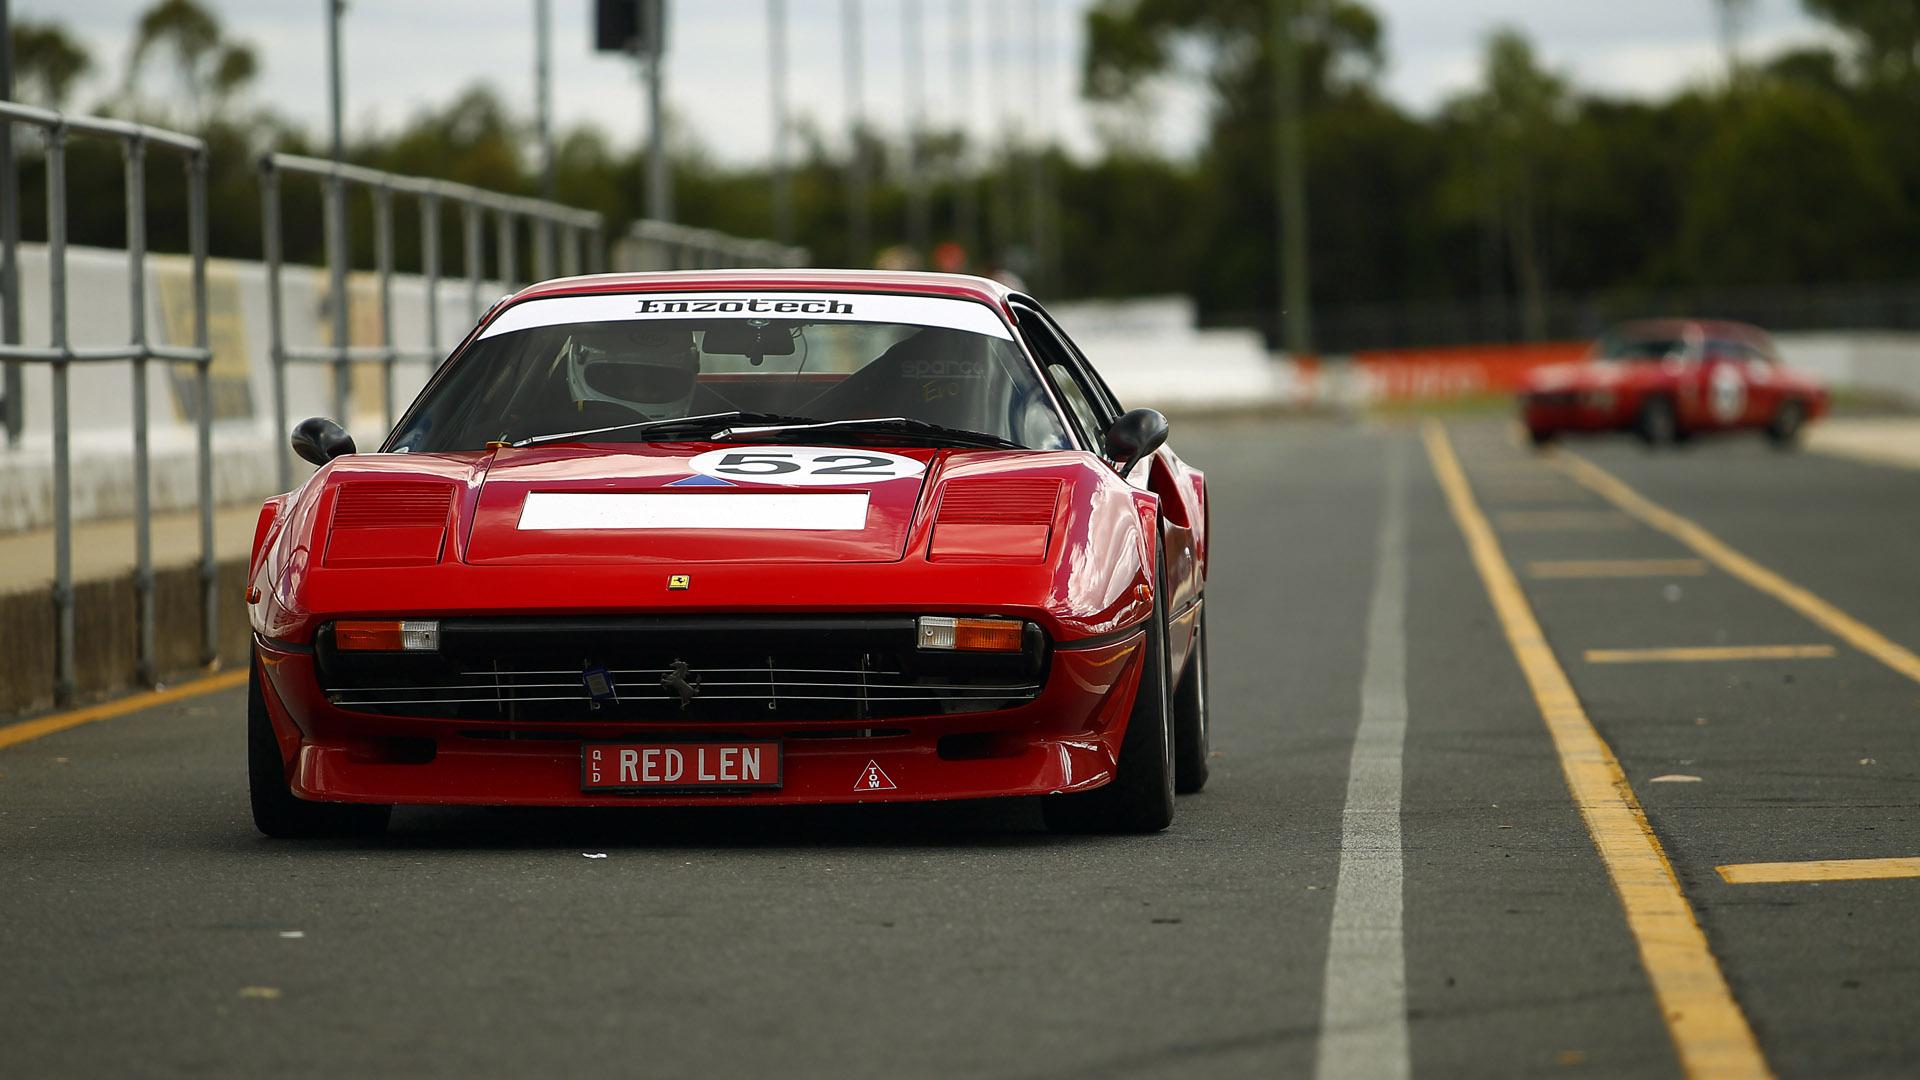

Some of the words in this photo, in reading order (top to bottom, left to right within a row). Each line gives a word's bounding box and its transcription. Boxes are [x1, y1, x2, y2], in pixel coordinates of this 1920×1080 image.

[634, 298, 855, 315] Enzotech
[714, 453, 897, 476] 52
[592, 749, 602, 783] QLD
[619, 748, 685, 782] RED
[697, 747, 761, 781] LEN
[868, 767, 880, 788] TOW
